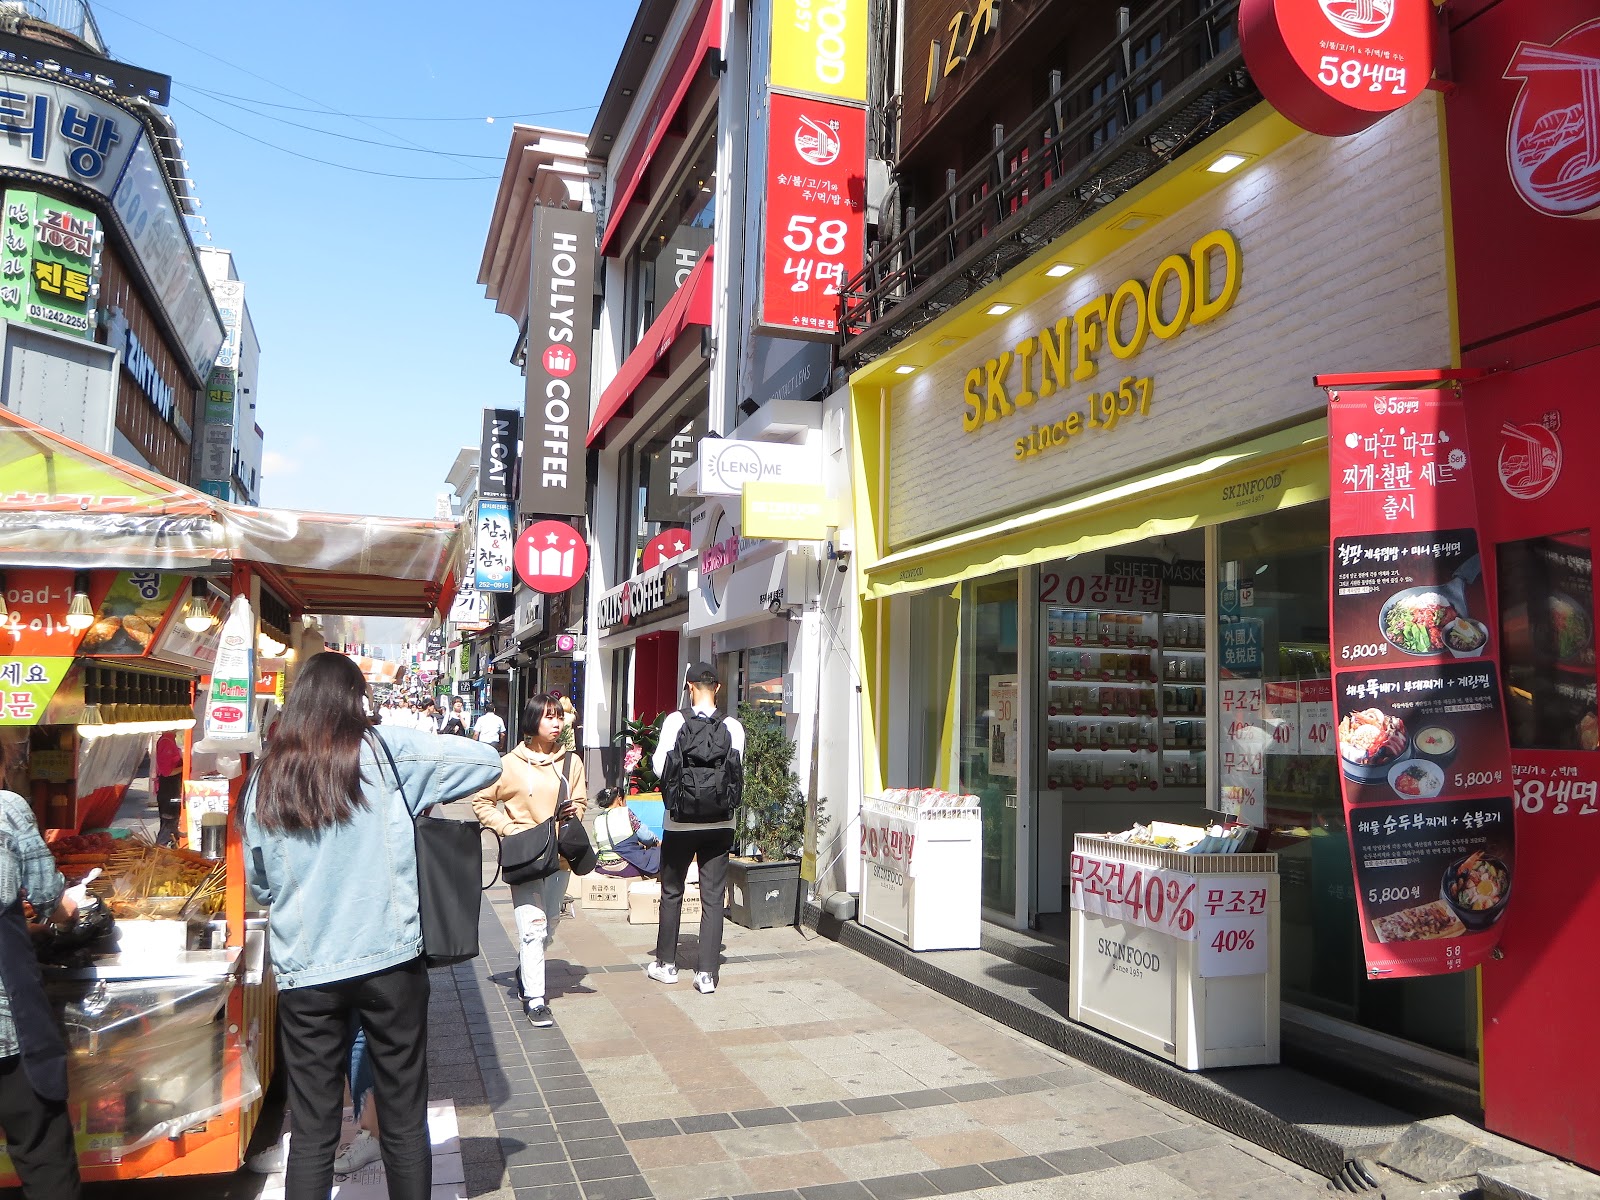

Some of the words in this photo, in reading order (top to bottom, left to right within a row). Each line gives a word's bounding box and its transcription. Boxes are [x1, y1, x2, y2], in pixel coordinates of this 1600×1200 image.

[816, 0, 847, 85] OOD
[1317, 56, 1407, 95] 58냉면
[783, 214, 848, 256] 58
[34, 261, 90, 302] 진툰
[548, 232, 578, 344] HOLLYS
[784, 257, 844, 296] 냉면
[29, 303, 89, 331] 031.242.2256
[962, 229, 1244, 433] SKINFOOD
[1014, 410, 1083, 461] since
[1087, 375, 1155, 431] 1957
[542, 379, 571, 489] COFFEE
[1364, 433, 1397, 460] 따끈
[1403, 432, 1436, 458] 따끈
[489, 419, 510, 486] N.CAT
[1450, 454, 1464, 464] Set
[1222, 473, 1282, 501] SKINFOOD
[1419, 461, 1457, 487] 세트
[1382, 493, 1415, 520] 출시
[481, 517, 511, 541] 참치
[479, 548, 507, 568] 참치
[1113, 561, 1158, 578] SHEET
[1162, 565, 1206, 583] MASKS
[8, 586, 73, 604] oad-1
[630, 571, 665, 617] COFFEE
[1039, 573, 1162, 605] 20장만원
[1225, 627, 1257, 646] 外國人
[1341, 643, 1388, 661] 5,800원
[1, 663, 48, 685] 세요
[1222, 689, 1261, 712] 무조건
[1308, 721, 1332, 744] 40%
[1454, 770, 1502, 789] 5,800원
[1358, 821, 1380, 836] 해물
[1462, 811, 1501, 830] 숯불고기
[1124, 870, 1196, 932] 40%
[1204, 888, 1267, 916] 무조건
[1368, 885, 1421, 904] 5,800원
[1211, 929, 1255, 952] 40%
[1446, 945, 1461, 957] 58
[1098, 937, 1161, 973] SKINFOOD
